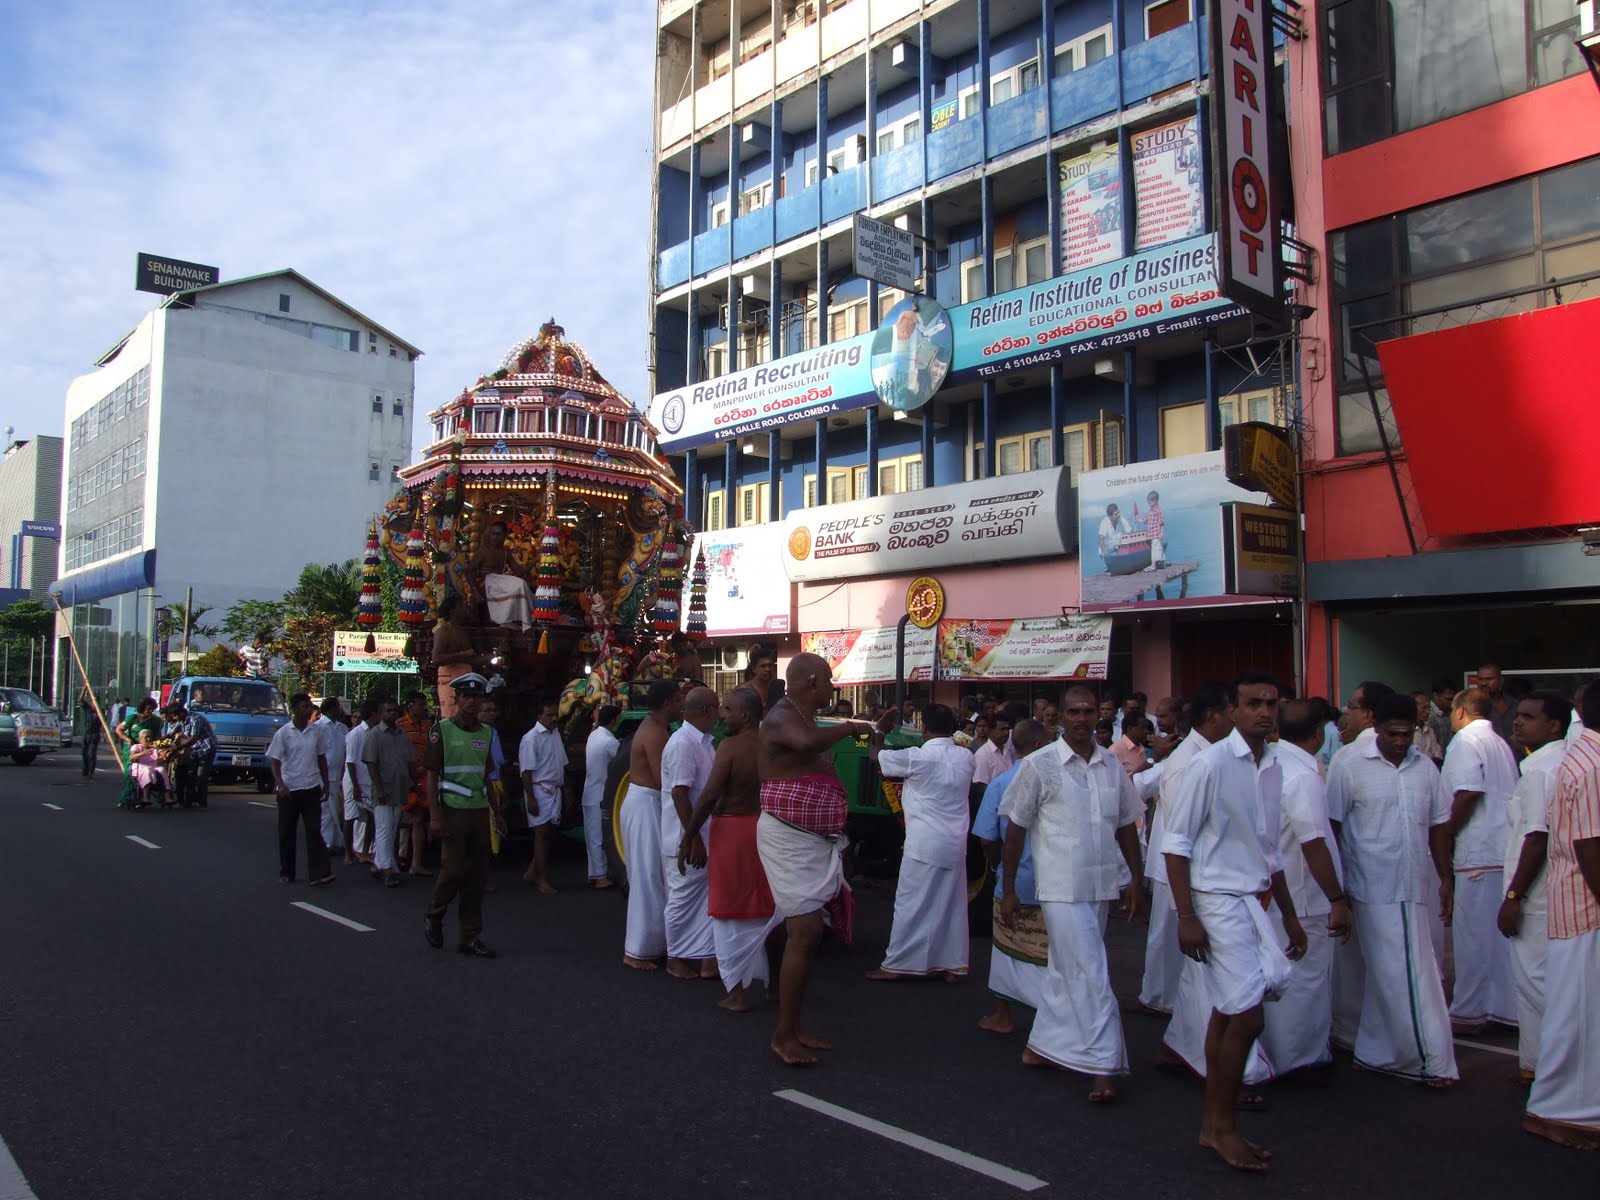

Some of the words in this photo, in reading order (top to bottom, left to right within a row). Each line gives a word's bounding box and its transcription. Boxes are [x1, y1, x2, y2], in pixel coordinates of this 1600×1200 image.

[932, 103, 955, 124] OBLE
[1135, 125, 1187, 151] STUDY
[1230, 0, 1267, 276] ARIOT
[1144, 141, 1183, 157] ABROAD
[1059, 161, 1092, 182] STUDY
[1140, 174, 1162, 185] MEDICINE
[1066, 190, 1076, 198] UK
[1140, 180, 1173, 194] ENGINEERING
[1067, 194, 1092, 207] CANADA
[1140, 192, 1162, 203] BUSINESS
[1140, 203, 1154, 211] HOTEL
[1155, 193, 1191, 207] MANAGEMENT
[1067, 207, 1079, 215] USA
[1068, 213, 1090, 224] CYPRUS
[1140, 209, 1165, 220] COMPUTER
[1166, 203, 1186, 213] SCIENCE
[1140, 217, 1164, 228] ACCOUNTS
[1170, 210, 1192, 220] FINANCE
[858, 216, 879, 234] FOREIGN
[881, 224, 911, 245] EMPLOYMENT
[1068, 219, 1101, 233] AUSTRALIA
[1068, 227, 1104, 242] SINGAPORE
[1140, 227, 1160, 237] FASHION
[1161, 220, 1190, 231] DESIGNING
[874, 234, 897, 247] AGENCY
[1068, 238, 1098, 251] MALAYSIA
[1083, 243, 1111, 255] ZEALAND
[147, 260, 210, 282] SENANAYAKE
[1068, 257, 1093, 269] POLAND
[970, 299, 1023, 329] Retina
[1029, 275, 1102, 313] Institute
[1109, 262, 1128, 290] of
[1134, 244, 1217, 284] Busines
[1029, 295, 1122, 327] EDUCATIONAL
[1128, 269, 1217, 300] CONSULTAN
[977, 364, 1002, 376] TEL:
[1004, 362, 1011, 370] 4
[1013, 350, 1062, 368] 510442-3
[1070, 341, 1098, 354] FAX:
[1101, 328, 1150, 347] 4723818
[1156, 316, 1202, 334] E-mail:
[693, 376, 747, 404] Retina
[755, 344, 862, 387] Recruiting
[713, 389, 765, 410] MANPOWER
[768, 372, 831, 395] CONSULTANT
[720, 428, 736, 438] 294,
[736, 421, 761, 435] GALLE
[761, 416, 787, 430] ROAD,
[788, 405, 830, 423] COLOMBO
[831, 403, 839, 412] 4.
[1129, 475, 1137, 484] the
[1138, 473, 1153, 483] future
[1154, 472, 1161, 481] of
[1161, 472, 1170, 480] our
[1171, 469, 1188, 478] nation
[1209, 464, 1221, 473] with
[963, 502, 1038, 526] மக்கள்
[818, 513, 885, 534] PEOPLE'S
[961, 518, 1024, 542] வங்கி
[1245, 520, 1287, 536] WESTERN
[815, 531, 854, 548] BANK
[855, 544, 874, 552] PEOPLE
[1258, 534, 1287, 549] UNION
